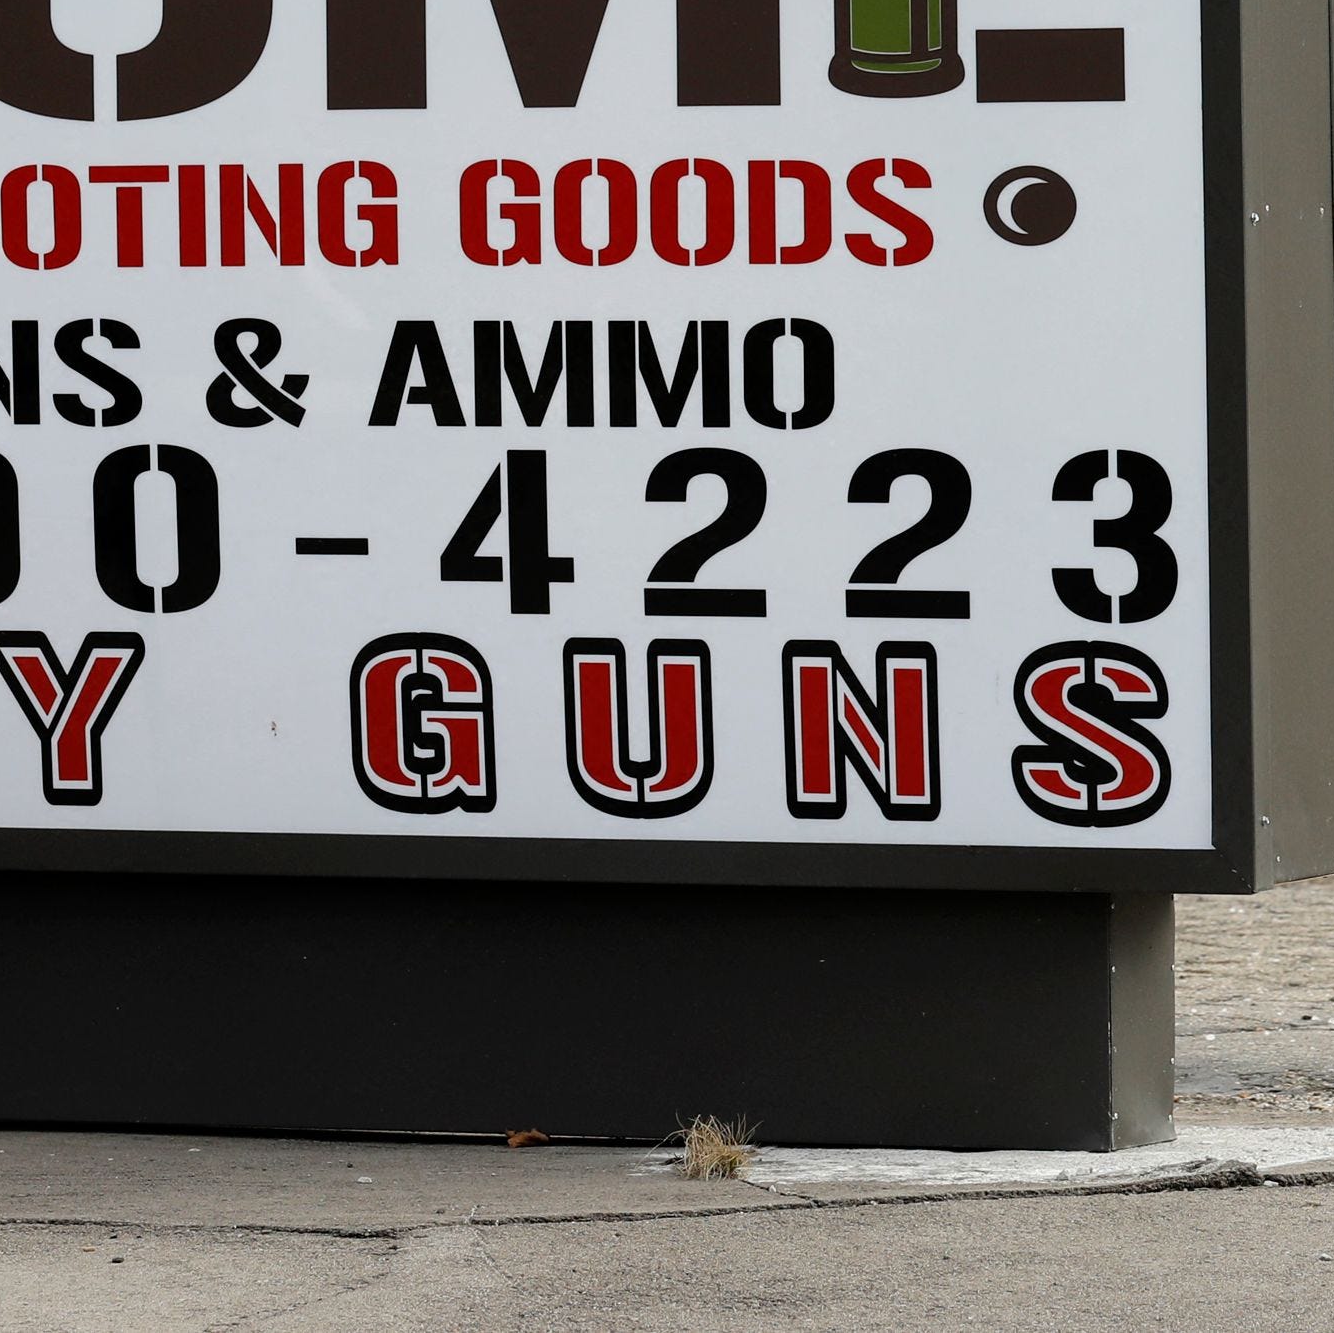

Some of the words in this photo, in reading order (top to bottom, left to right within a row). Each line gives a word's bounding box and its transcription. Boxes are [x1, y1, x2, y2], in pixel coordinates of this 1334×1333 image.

[459, 158, 935, 267] GOODS
[205, 317, 310, 429] &
[367, 317, 836, 430] AMMO
[349, 632, 1172, 828] GUNS
